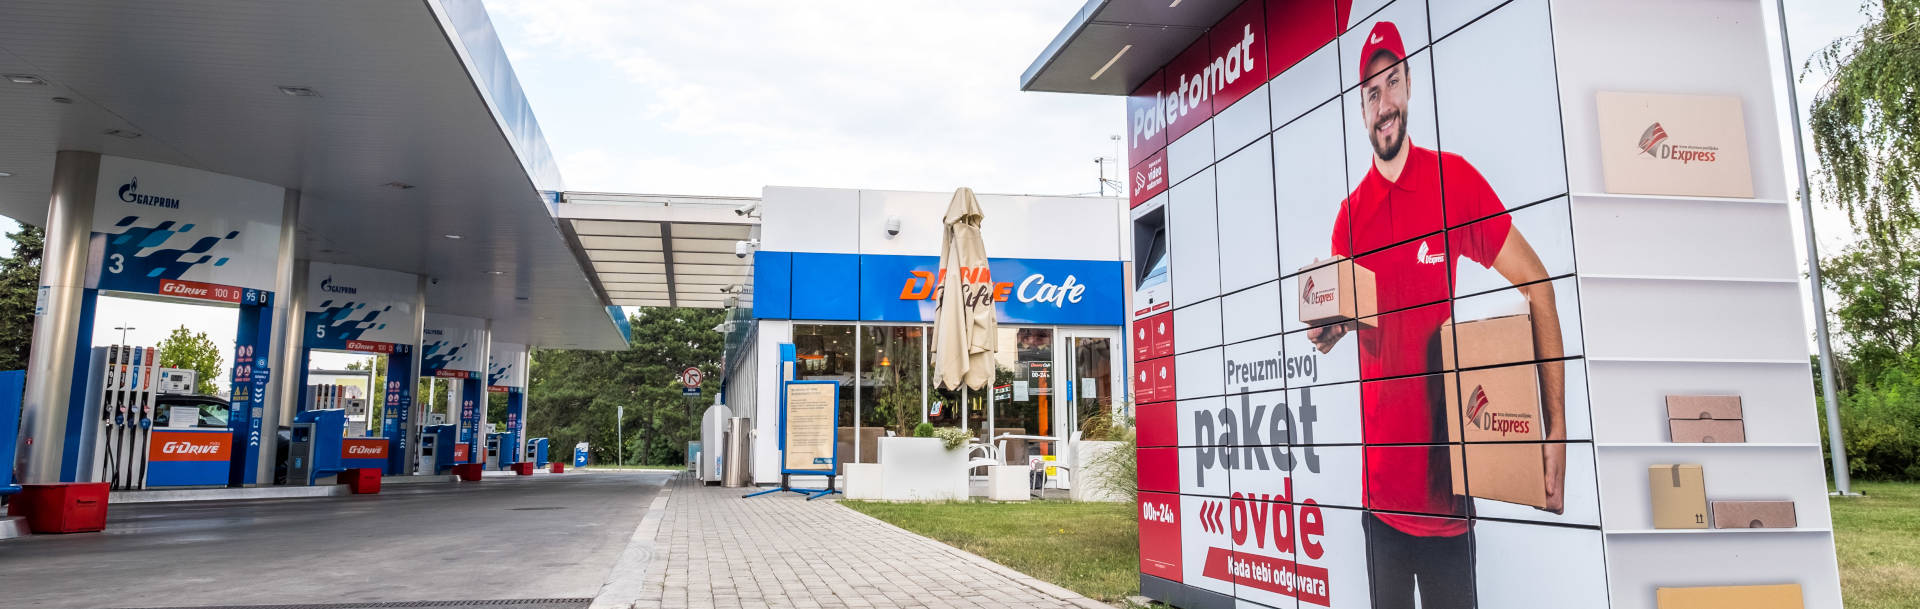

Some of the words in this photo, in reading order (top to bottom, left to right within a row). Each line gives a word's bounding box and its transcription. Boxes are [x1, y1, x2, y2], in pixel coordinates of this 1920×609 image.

[1133, 23, 1255, 149] Paketomat
[136, 194, 180, 210] GAZPROM
[108, 253, 125, 274] 3
[214, 288, 228, 299] 100
[233, 290, 240, 300] D
[246, 291, 256, 302] 95
[1016, 273, 1086, 308] Cafe
[316, 324, 326, 339] 5
[1227, 351, 1282, 385] Preuzmi
[1287, 347, 1318, 383] svoj
[1194, 386, 1321, 487] paket
[1143, 501, 1174, 524] 00h-24h
[1230, 476, 1325, 560] ovde
[1227, 555, 1251, 577] Kada
[1252, 560, 1272, 582] tebi
[1273, 567, 1326, 597] odgovara
